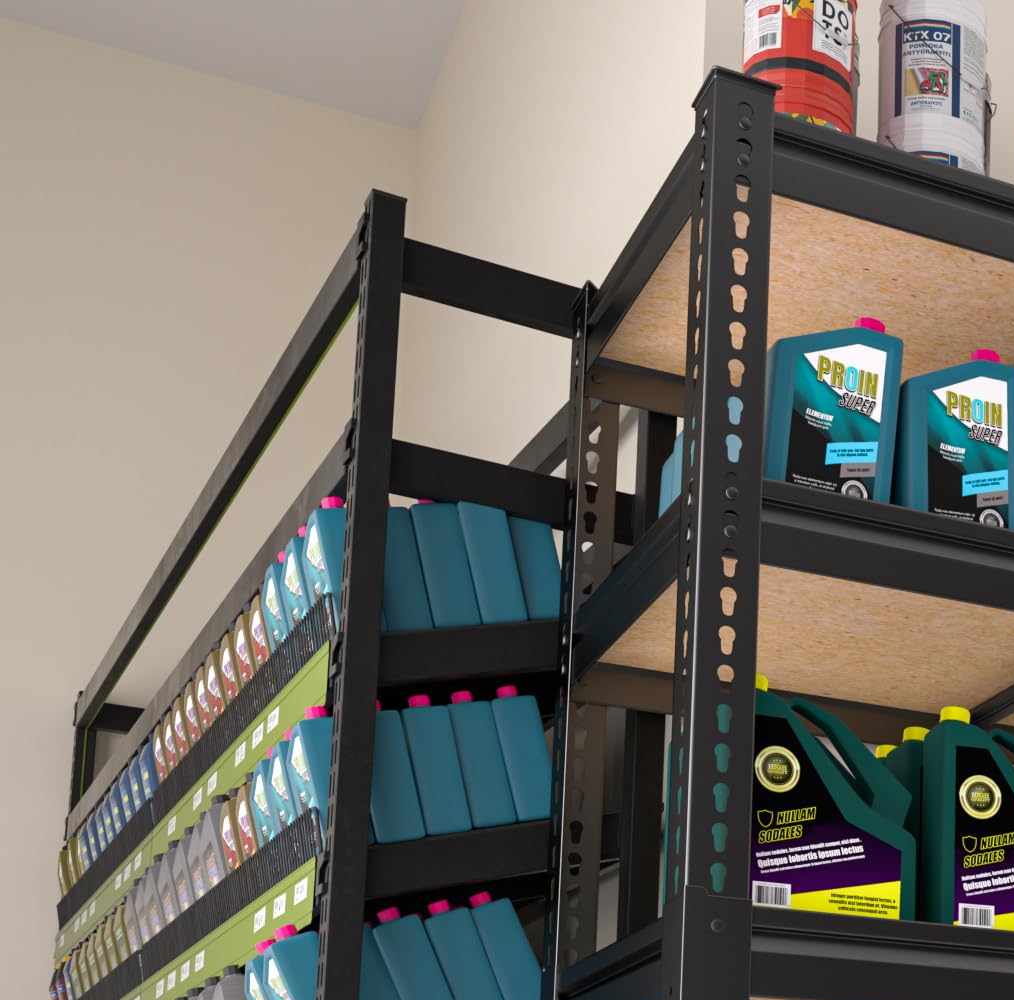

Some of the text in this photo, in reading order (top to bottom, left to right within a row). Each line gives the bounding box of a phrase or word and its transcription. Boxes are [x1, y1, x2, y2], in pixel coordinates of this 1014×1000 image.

[903, 30, 951, 42] KTX 07
[817, 355, 878, 399] PROIN
[838, 393, 877, 417] SUPER
[946, 390, 1003, 429] PROIN
[969, 425, 1003, 446] SUPER
[776, 806, 817, 826] NULLAM
[758, 824, 803, 844] SODALES
[963, 849, 1005, 869] SODALES
